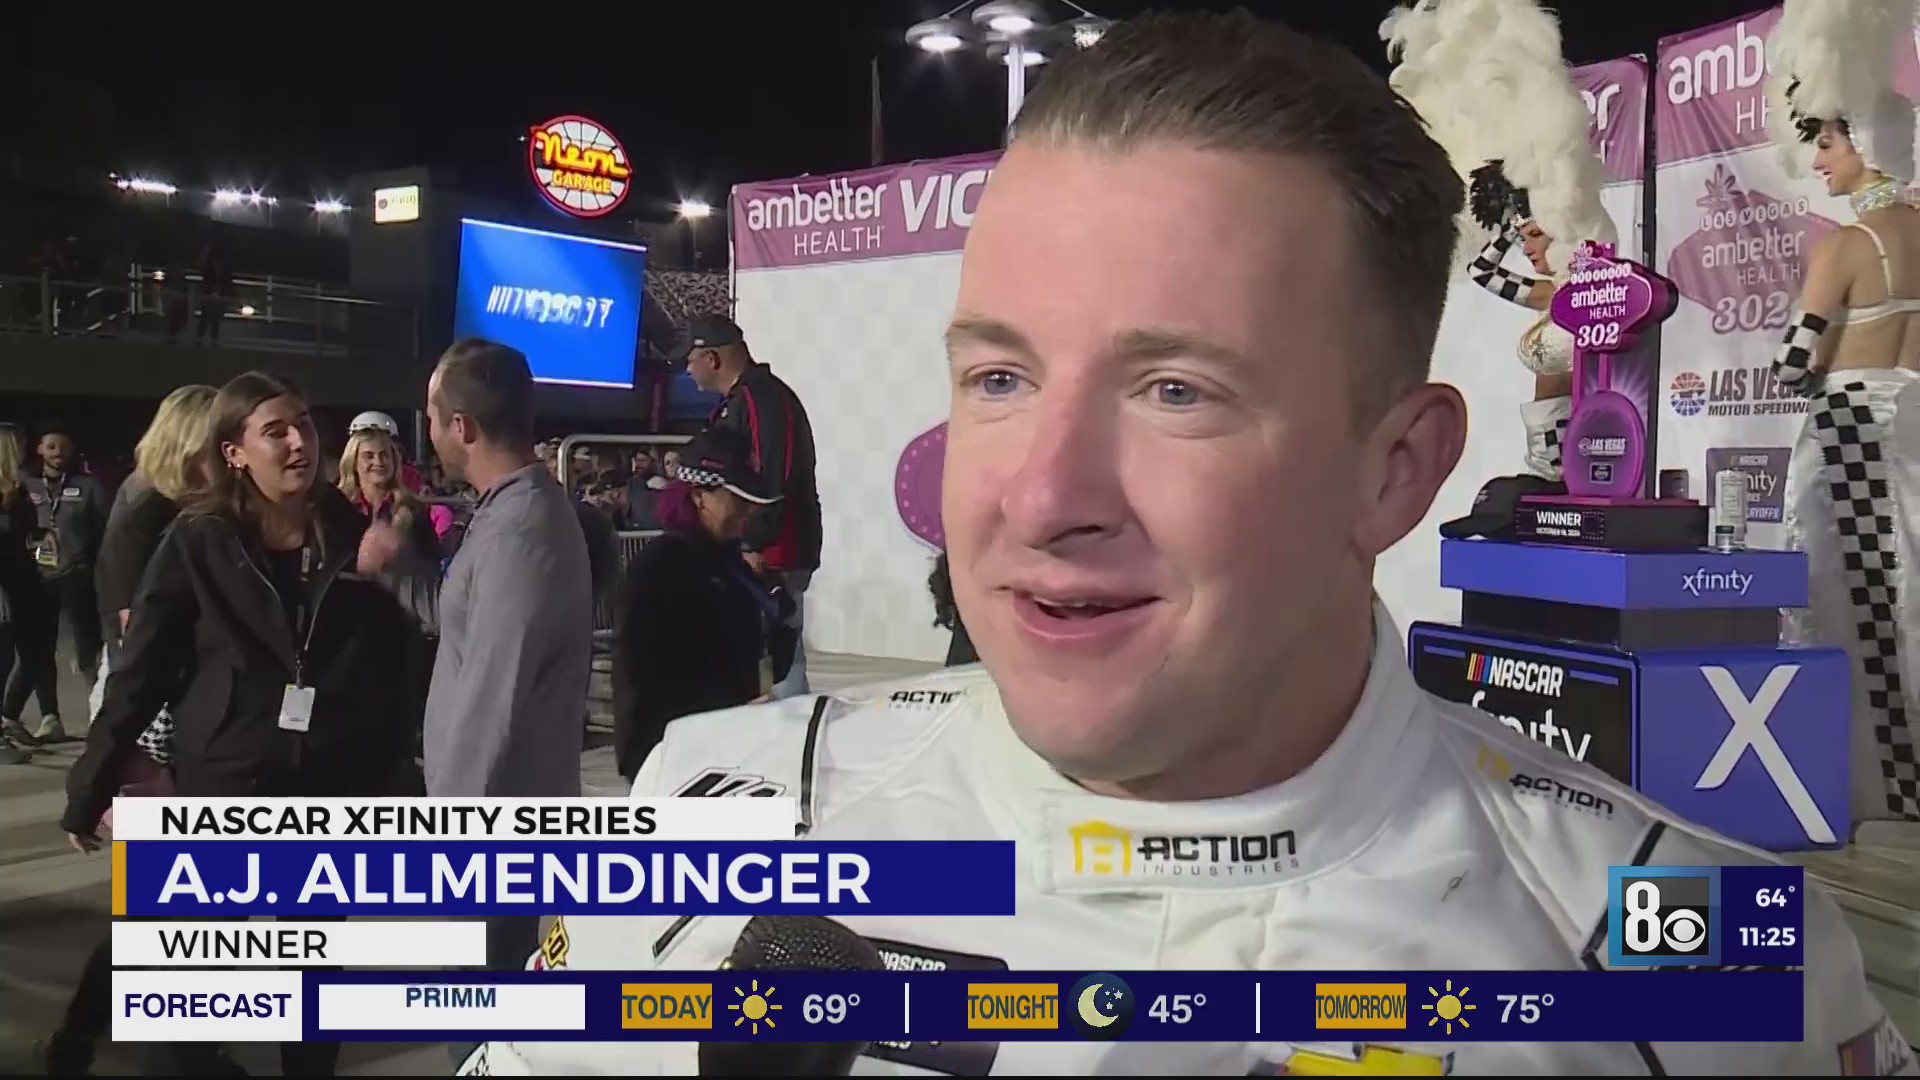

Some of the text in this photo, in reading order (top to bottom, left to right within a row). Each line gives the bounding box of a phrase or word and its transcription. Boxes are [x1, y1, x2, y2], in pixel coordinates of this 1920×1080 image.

[535, 131, 629, 176] Neon
[552, 170, 612, 193] GARAGE
[748, 169, 1000, 233] ambetter VIC
[1700, 197, 1808, 231] LAS VEGAS
[794, 226, 882, 256] HEALTH
[1701, 228, 1805, 269] ambetter
[1737, 263, 1801, 286] HEALTH
[1571, 282, 1629, 308] ambetter
[1589, 305, 1626, 319] HEALTH
[1712, 290, 1792, 334] 302
[1577, 322, 1620, 347] 302
[1709, 369, 1748, 402] LAS
[1708, 401, 1809, 416] MOTOR SPEEDW
[1746, 469, 1777, 496] nity
[1536, 511, 1582, 527] WINNER
[1682, 567, 1753, 597] xfinity
[1488, 656, 1564, 697] NASCAR
[1510, 774, 1613, 814] ACTION
[1137, 830, 1296, 863] ACTION
[1142, 858, 1299, 877] INDUSTRIES
